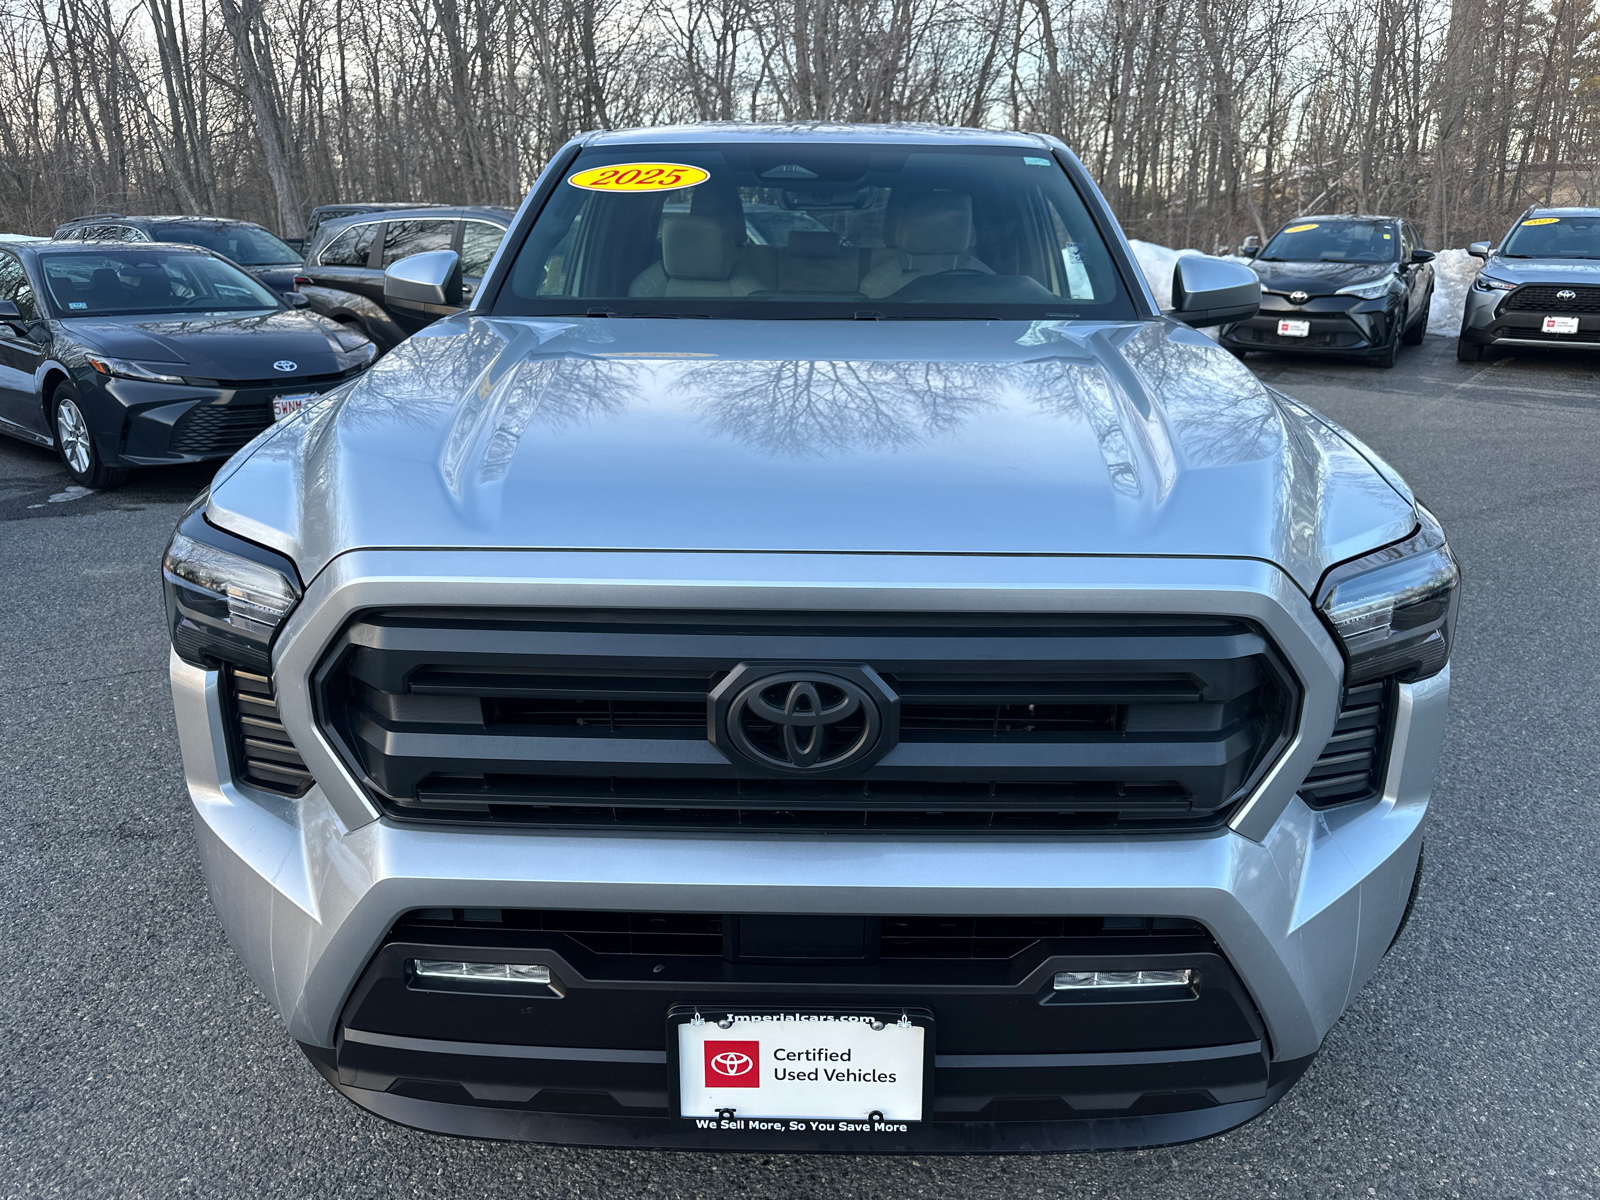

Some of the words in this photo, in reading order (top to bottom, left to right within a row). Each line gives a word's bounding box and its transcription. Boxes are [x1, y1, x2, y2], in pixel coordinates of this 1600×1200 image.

[589, 168, 689, 186] 2025
[773, 1048, 852, 1062] Certified
[774, 1068, 819, 1081] Used
[824, 1069, 897, 1083] Vehicles
[695, 1119, 718, 1130] We
[720, 1119, 745, 1130] Sell
[748, 1120, 786, 1132] More,
[789, 1120, 806, 1131] So
[810, 1121, 835, 1131] You
[838, 1121, 871, 1132] Save
[874, 1122, 908, 1132] More
